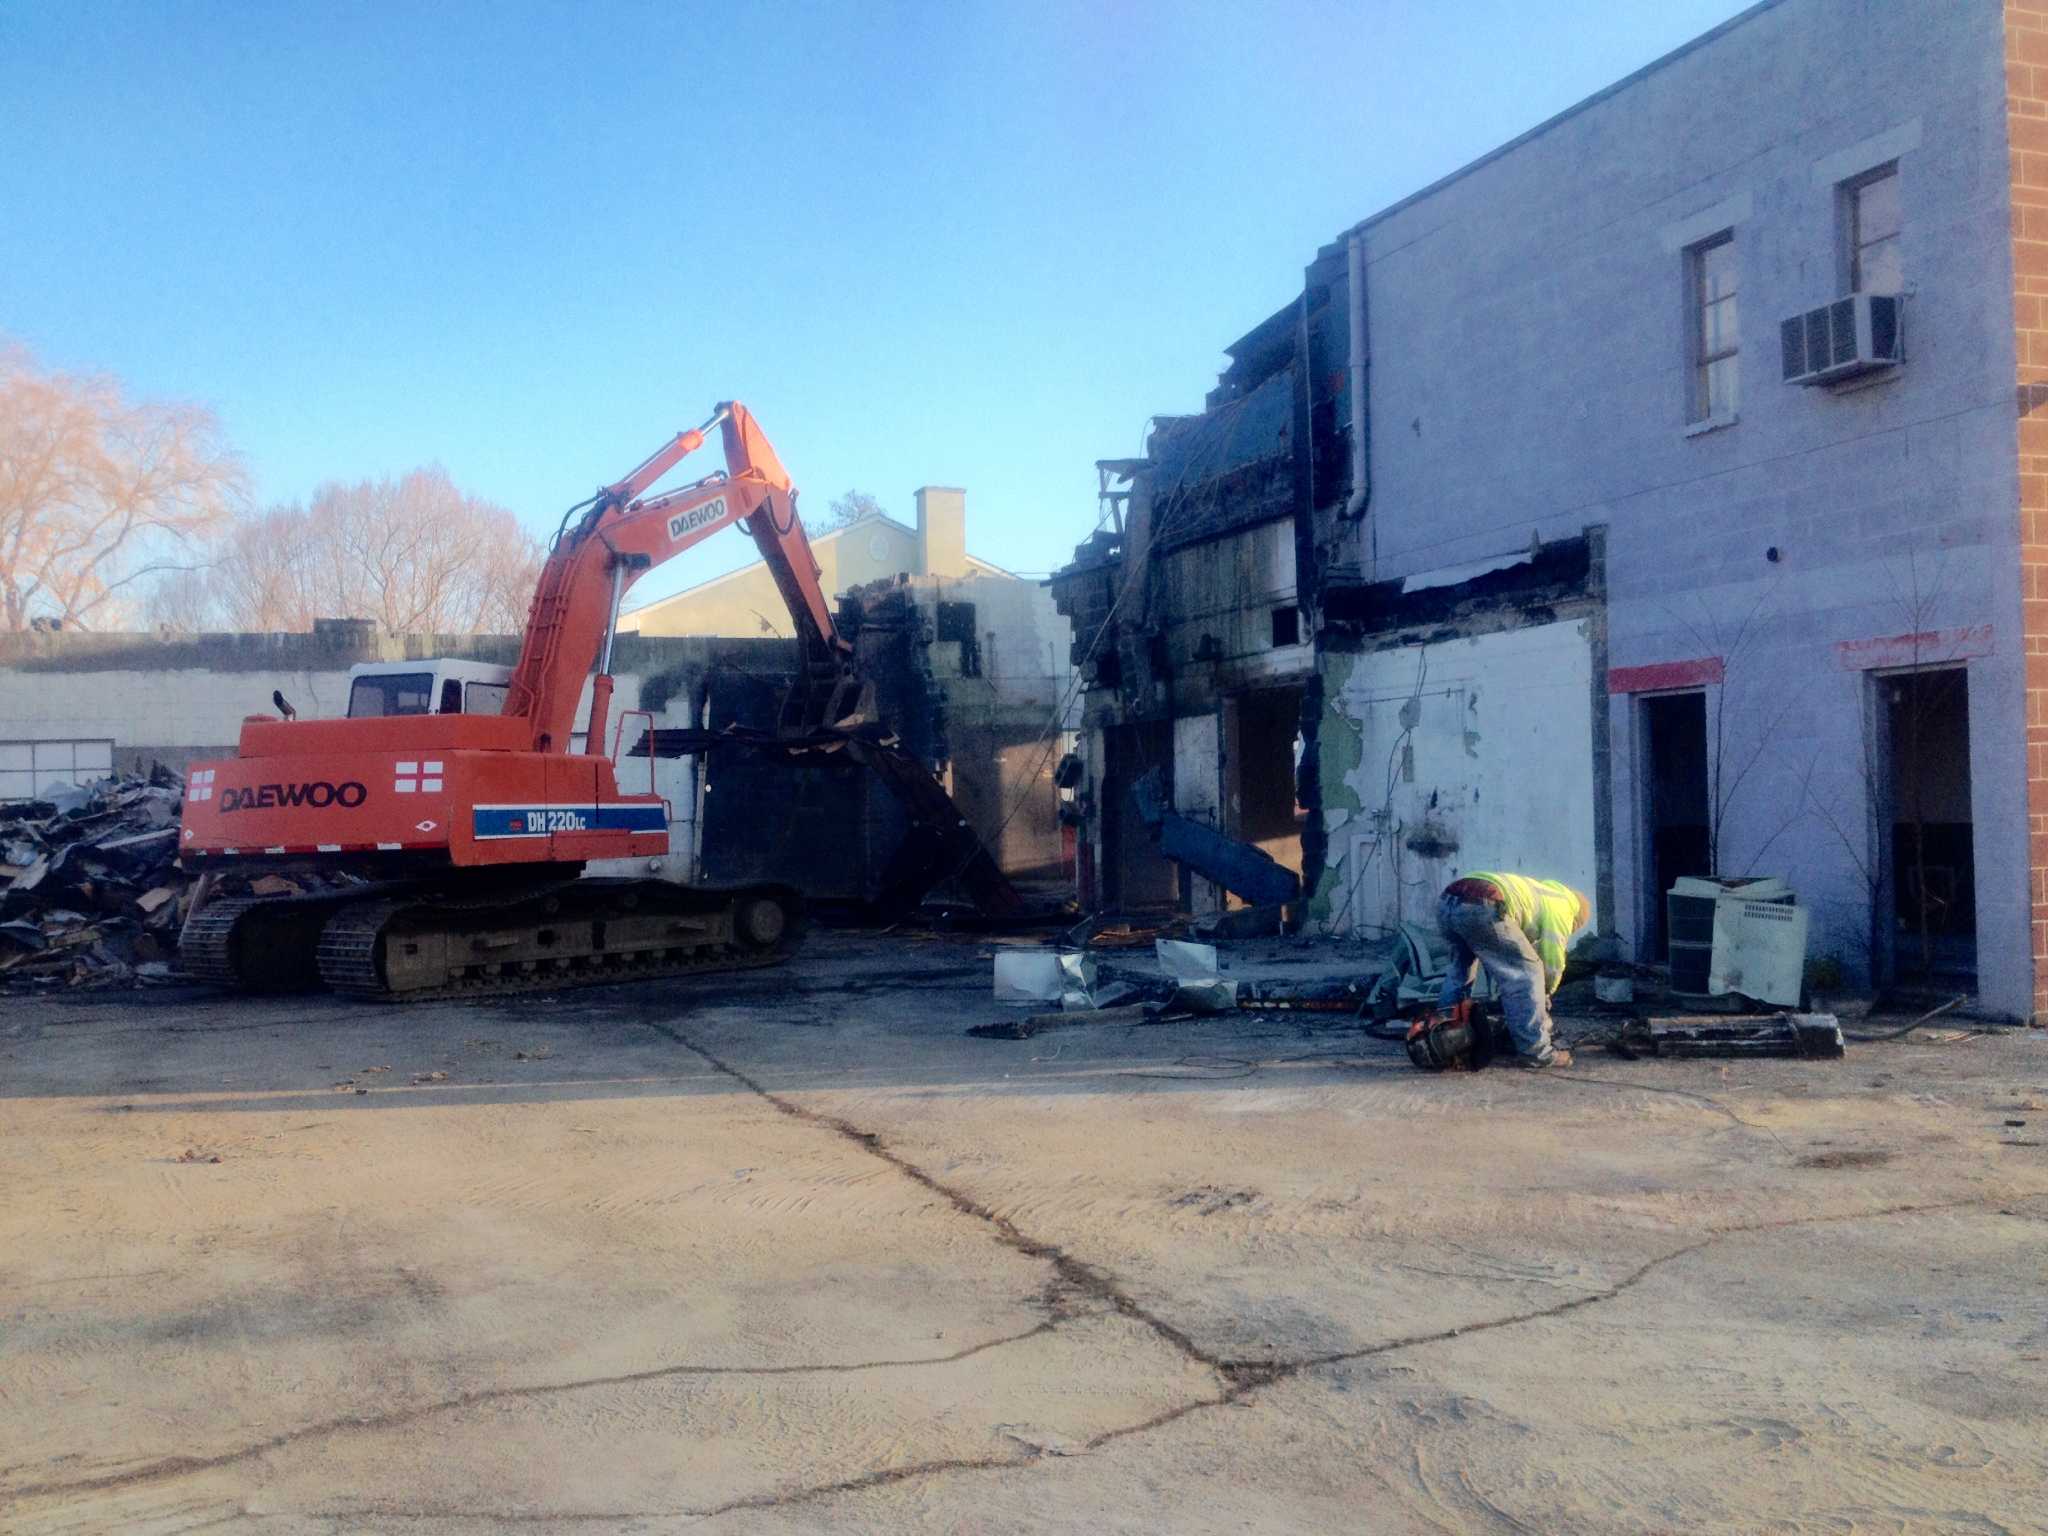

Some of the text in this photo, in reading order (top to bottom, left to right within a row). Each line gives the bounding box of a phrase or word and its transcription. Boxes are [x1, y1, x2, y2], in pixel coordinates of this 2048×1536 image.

[670, 499, 725, 537] DAEWOO
[220, 781, 367, 813] DAEWOO
[527, 812, 546, 832] DH
